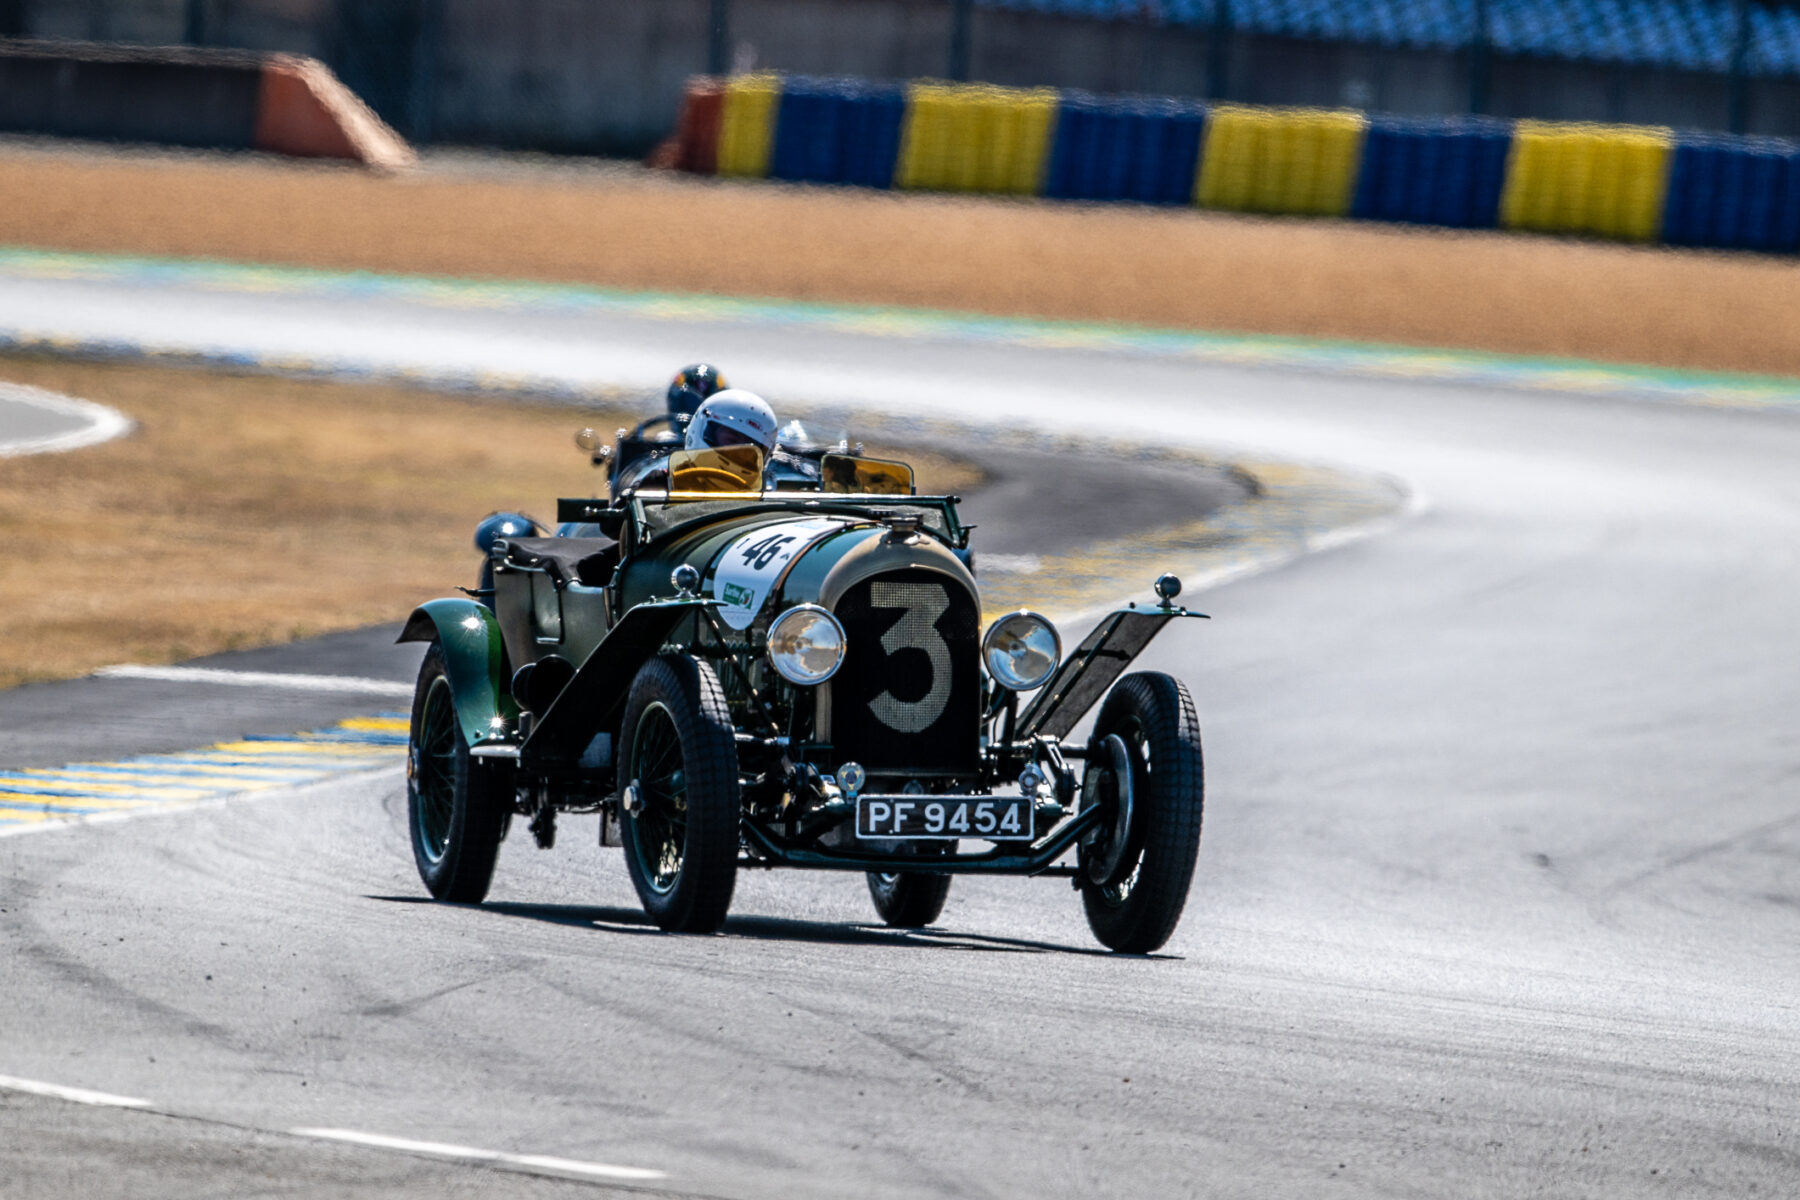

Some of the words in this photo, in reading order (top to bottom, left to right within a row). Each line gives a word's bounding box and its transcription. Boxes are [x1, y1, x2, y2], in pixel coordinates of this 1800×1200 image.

[741, 533, 797, 571] 46
[867, 581, 953, 734] 3
[868, 802, 916, 833] PF
[924, 802, 1022, 834] 9454
